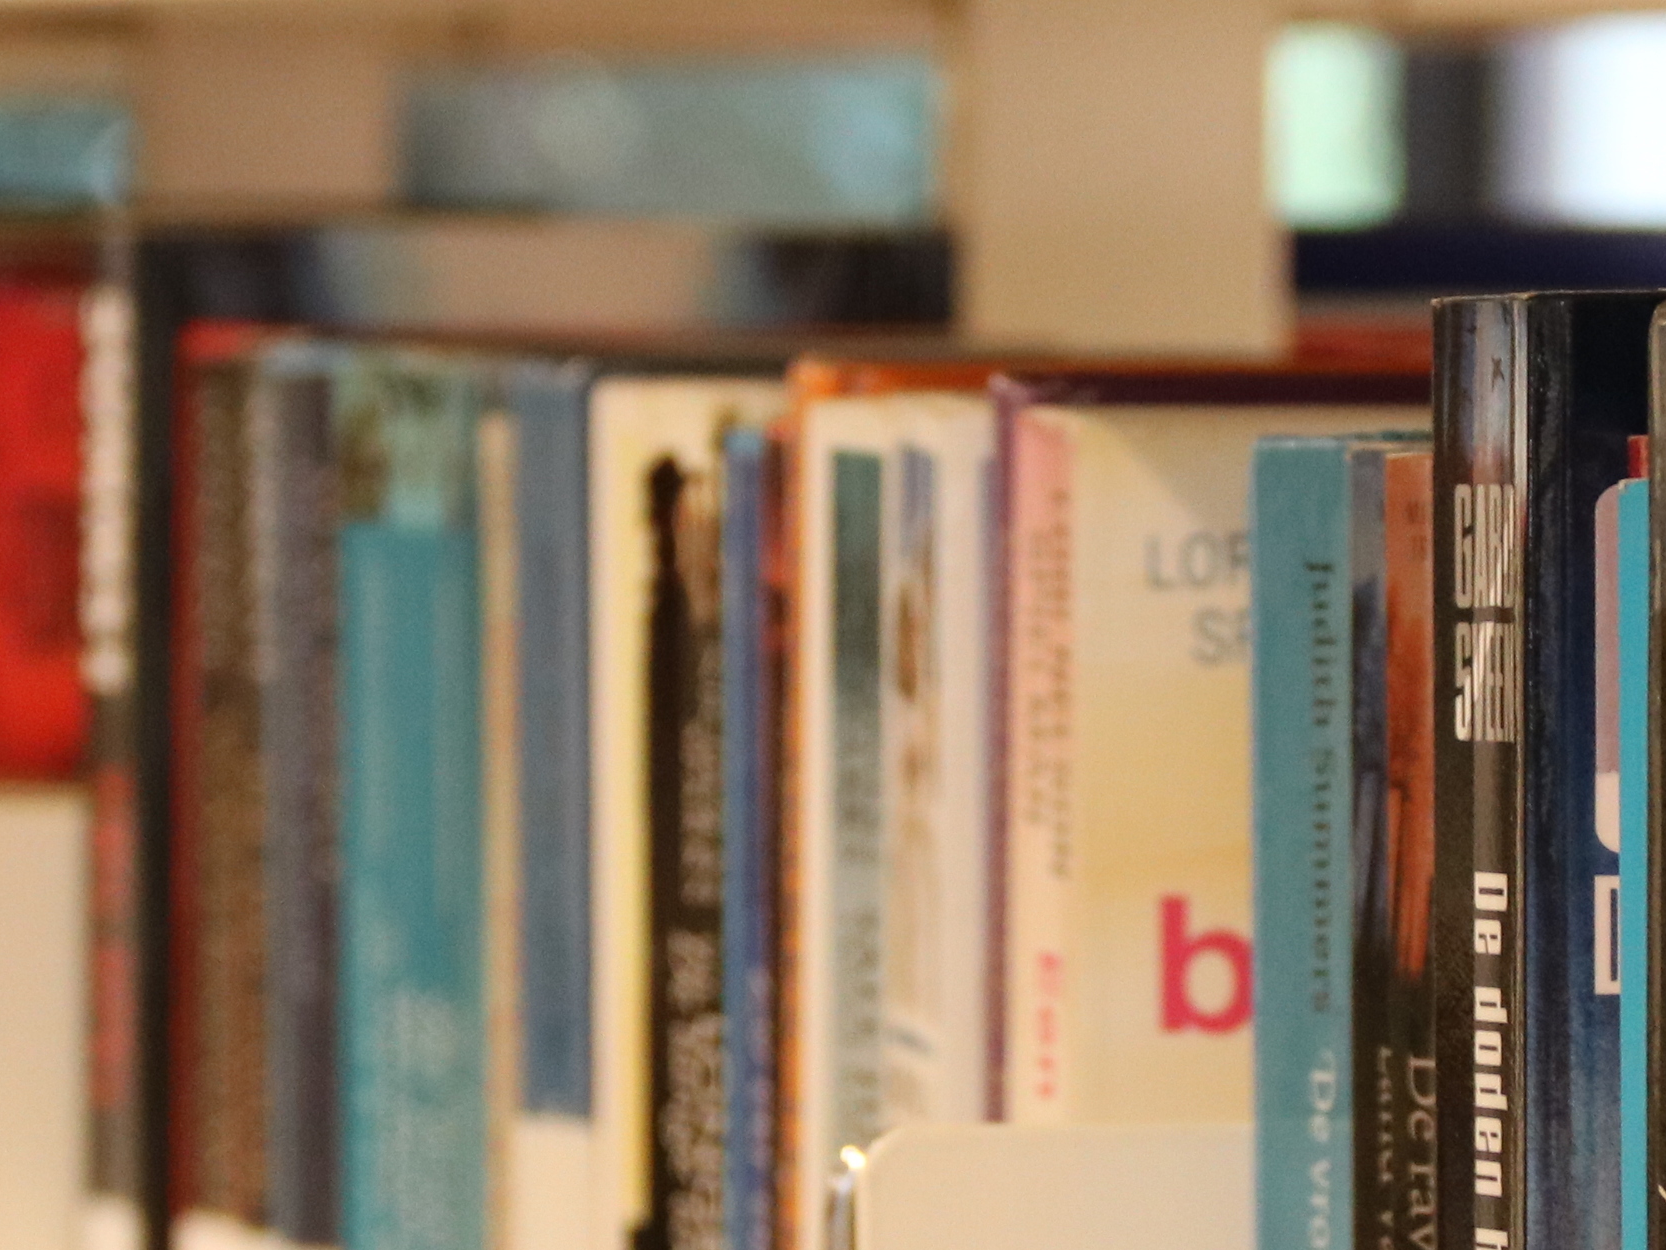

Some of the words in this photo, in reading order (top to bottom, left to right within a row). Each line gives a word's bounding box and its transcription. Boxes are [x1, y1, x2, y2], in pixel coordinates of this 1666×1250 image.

[1474, 871, 1508, 956] De
[1407, 1056, 1436, 1142] De
[1474, 986, 1509, 1197] doden
